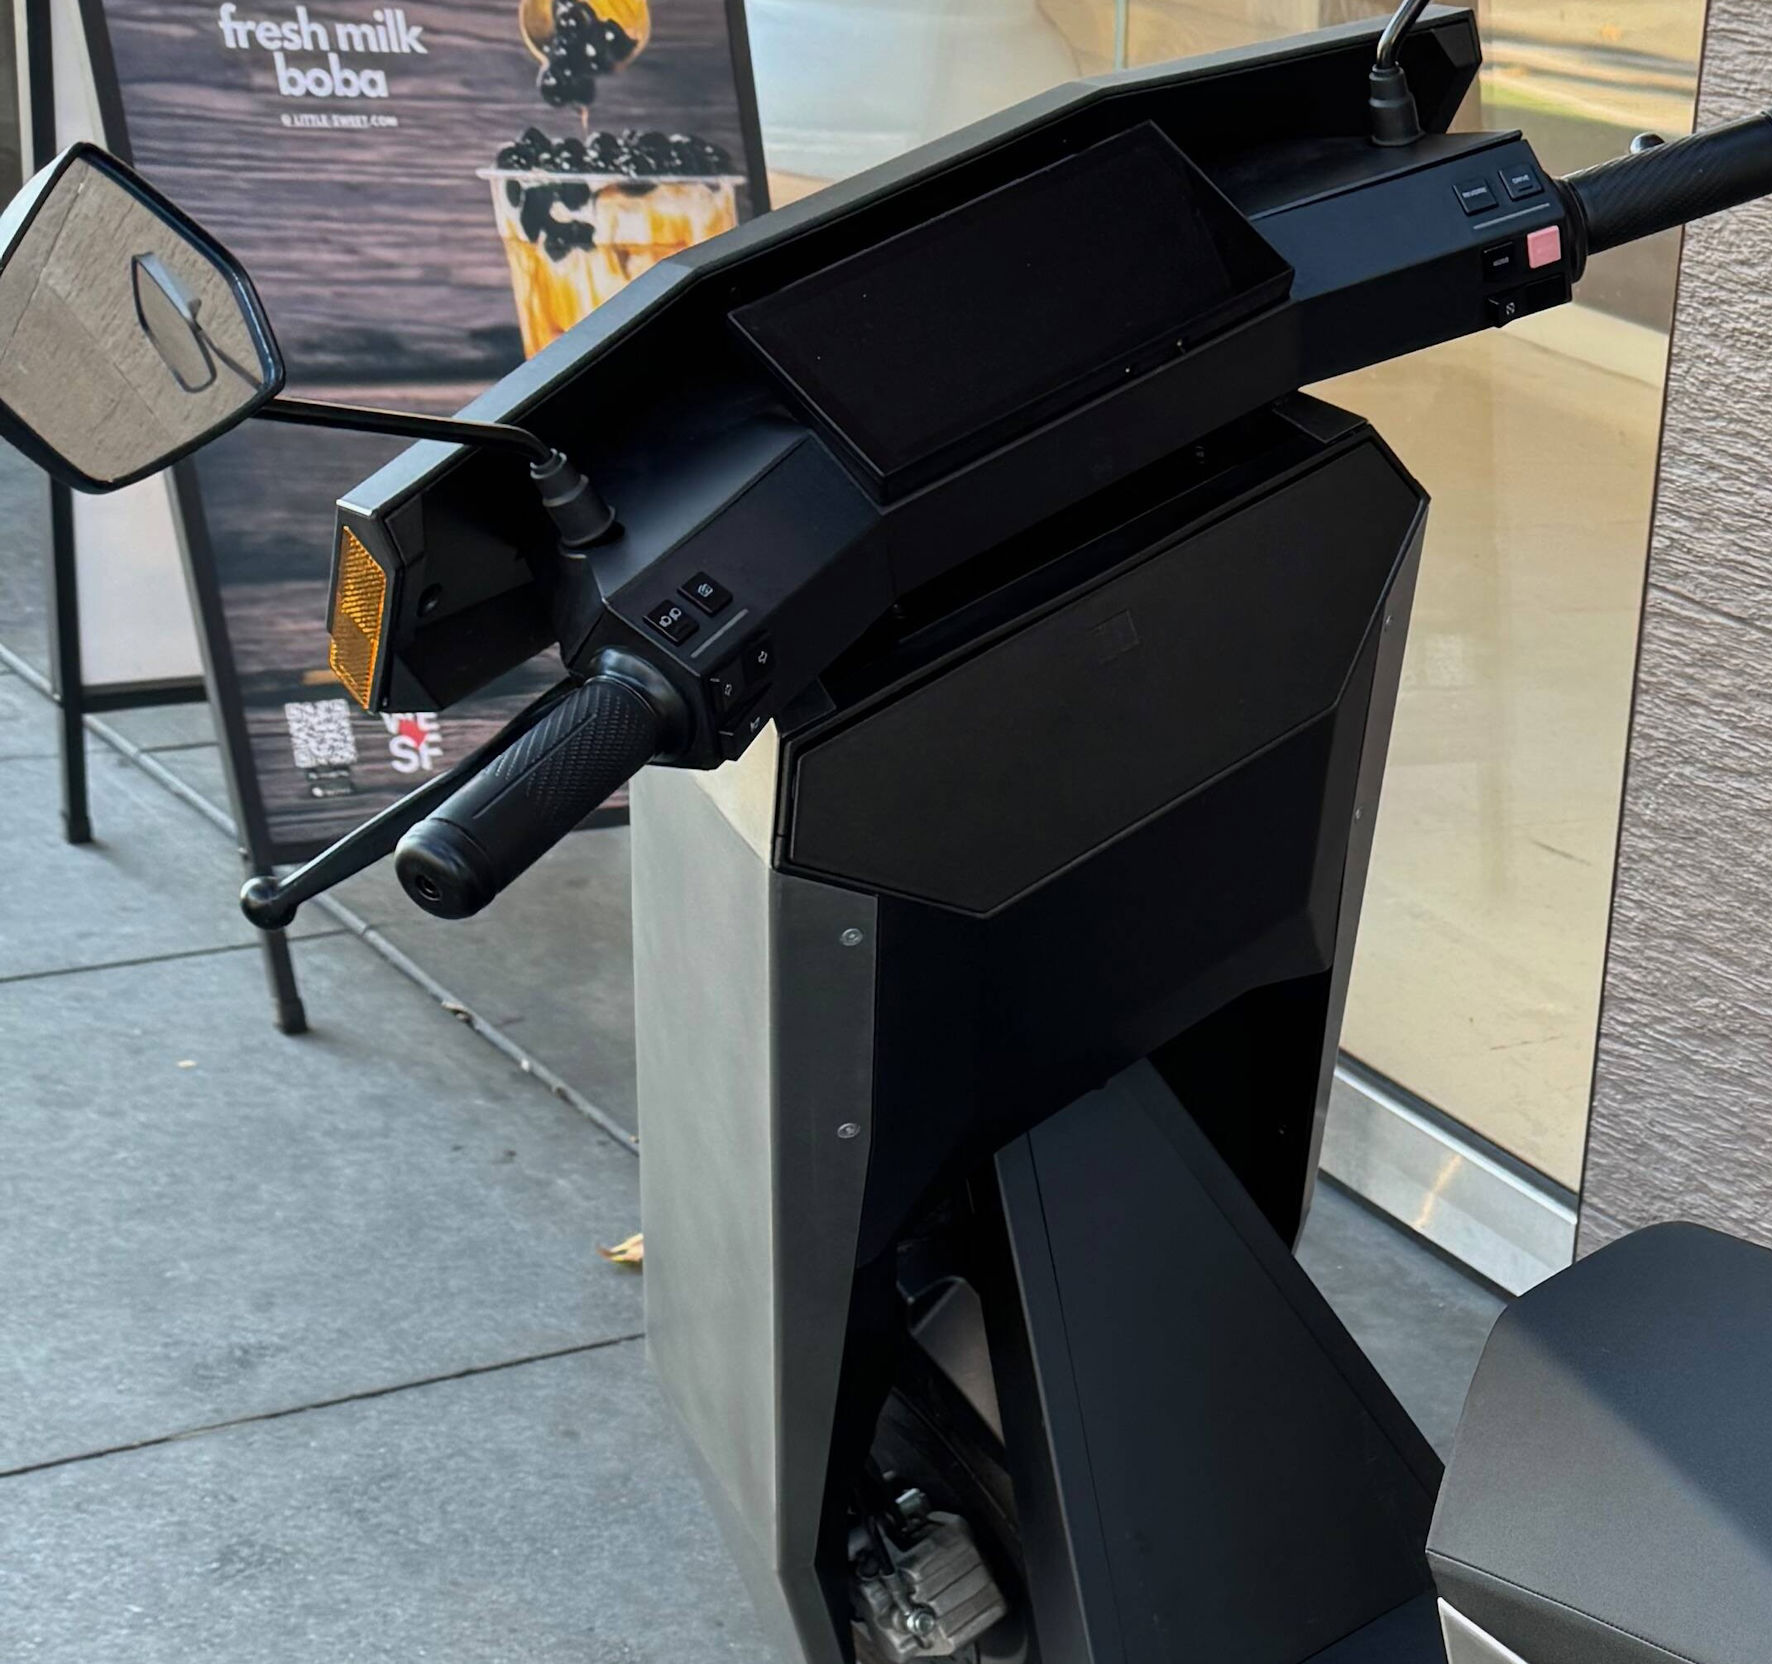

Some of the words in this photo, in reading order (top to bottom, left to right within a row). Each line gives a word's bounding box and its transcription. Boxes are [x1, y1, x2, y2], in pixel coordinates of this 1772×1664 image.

[218, 2, 330, 50] fresh
[334, 8, 428, 55] milk
[273, 51, 389, 98] boba
[389, 733, 443, 773] SF
